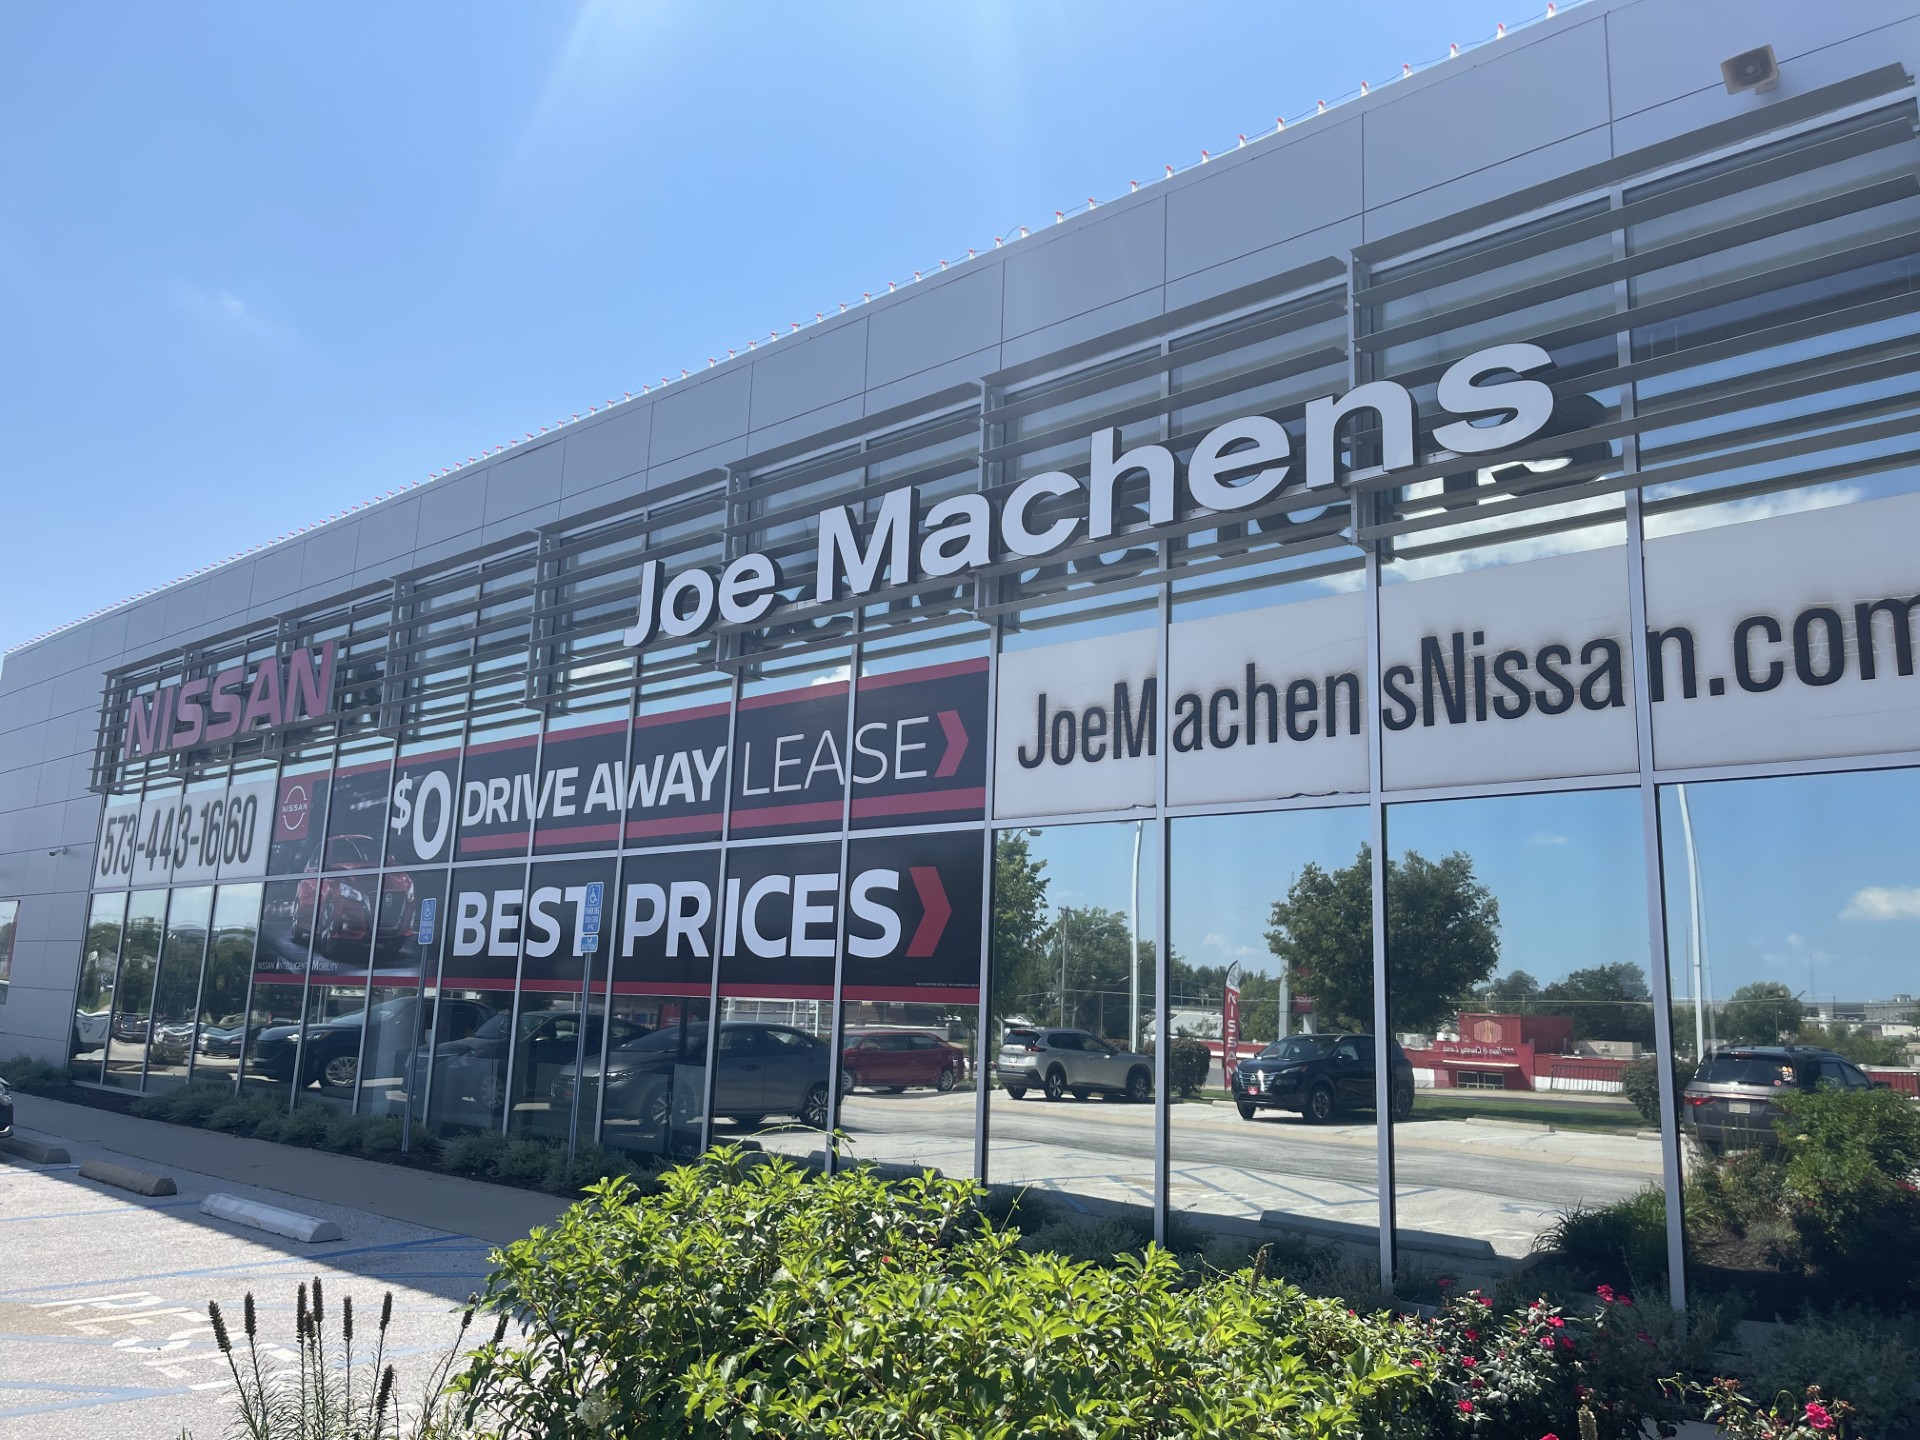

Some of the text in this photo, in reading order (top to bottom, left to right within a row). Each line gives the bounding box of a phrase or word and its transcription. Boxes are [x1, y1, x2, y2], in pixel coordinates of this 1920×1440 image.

[623, 343, 1554, 647] Joe Machens
[125, 640, 334, 759] NISSAN
[1018, 594, 1920, 769] JoeMachensNissan.com
[281, 803, 308, 813] NISSAN
[391, 716, 929, 860] $0 DRIVE AWAY LEASE
[101, 794, 258, 877] 573-443-1660
[453, 868, 901, 959] BEST PRICES
[312, 960, 339, 971] MOBILITY
[1226, 992, 1237, 1079] NISSAN
